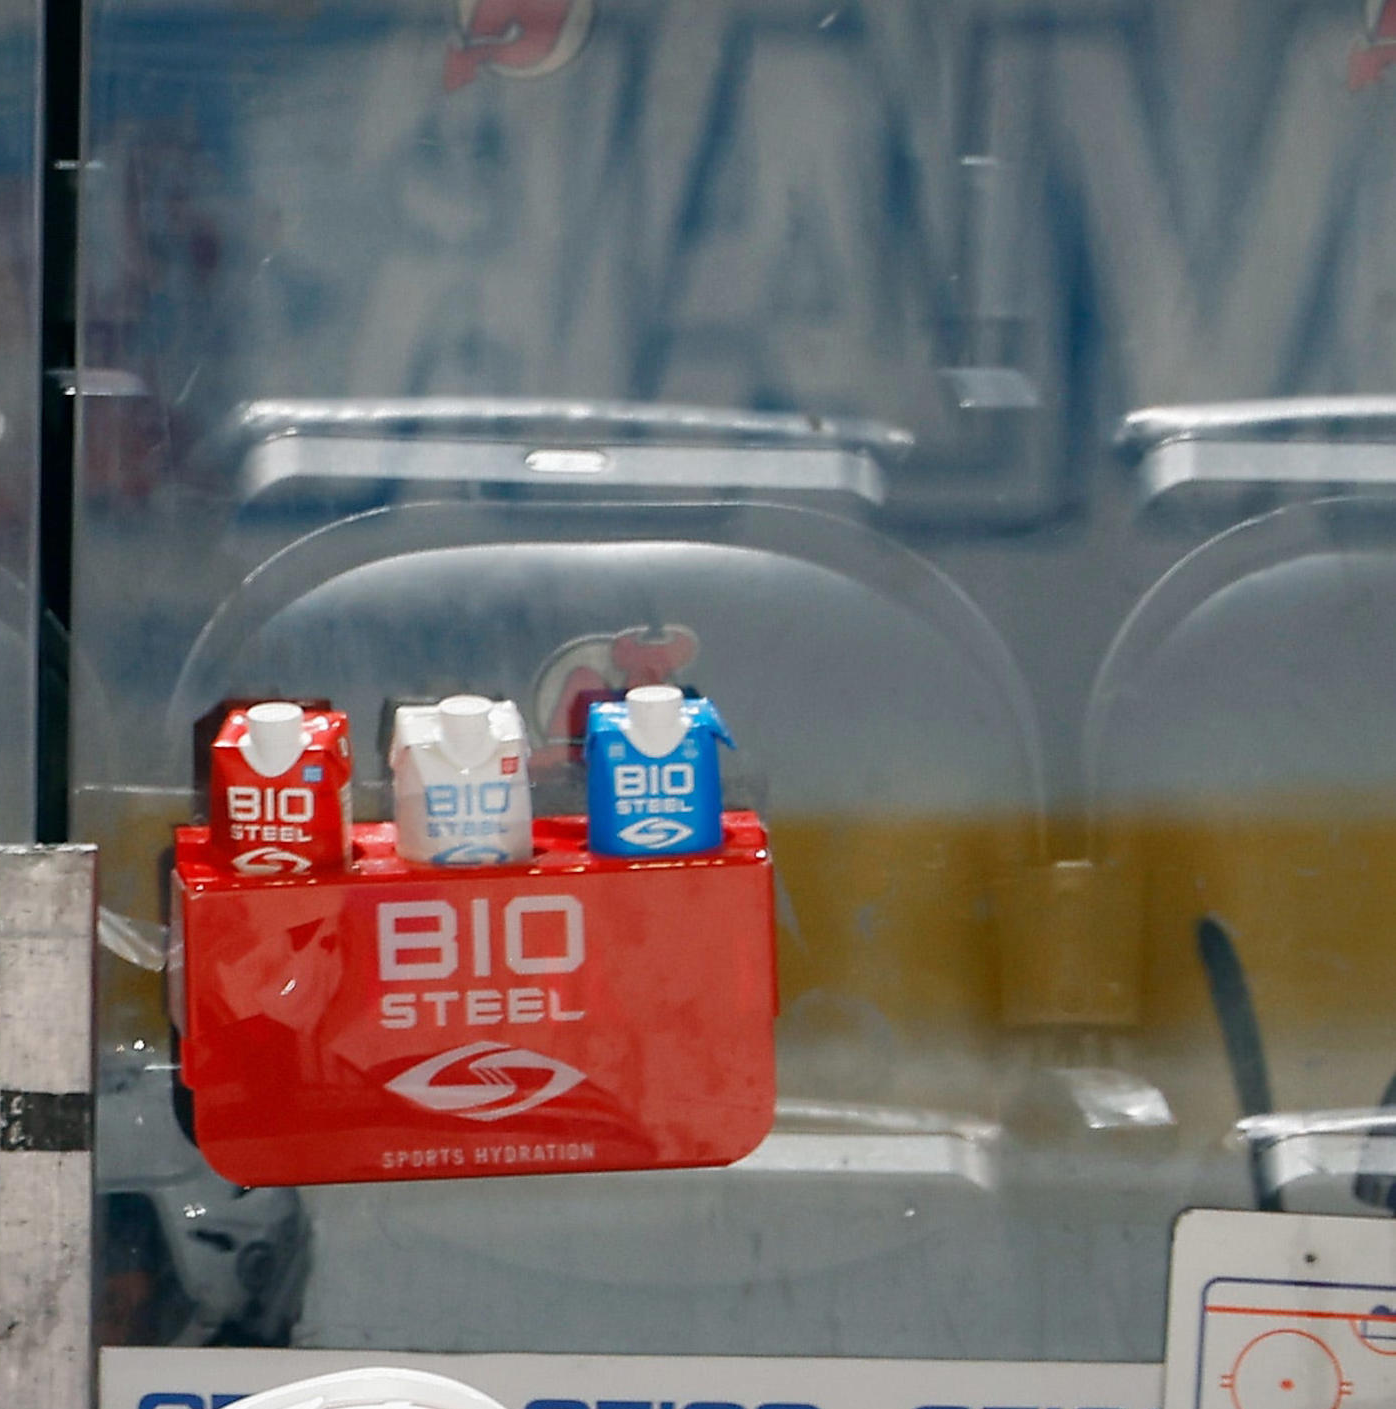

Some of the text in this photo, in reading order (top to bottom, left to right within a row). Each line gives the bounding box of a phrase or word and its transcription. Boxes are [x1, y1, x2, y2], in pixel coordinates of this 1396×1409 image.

[614, 763, 695, 798] BIO
[227, 786, 314, 823] BIO
[426, 781, 510, 817] BIO
[615, 797, 694, 815] STEEL
[230, 825, 313, 842] STEEL
[427, 820, 508, 838] STEEL
[377, 894, 585, 981] BIO
[380, 987, 585, 1029] STEEL
[382, 1142, 596, 1169] SPORTS HYDRATION
